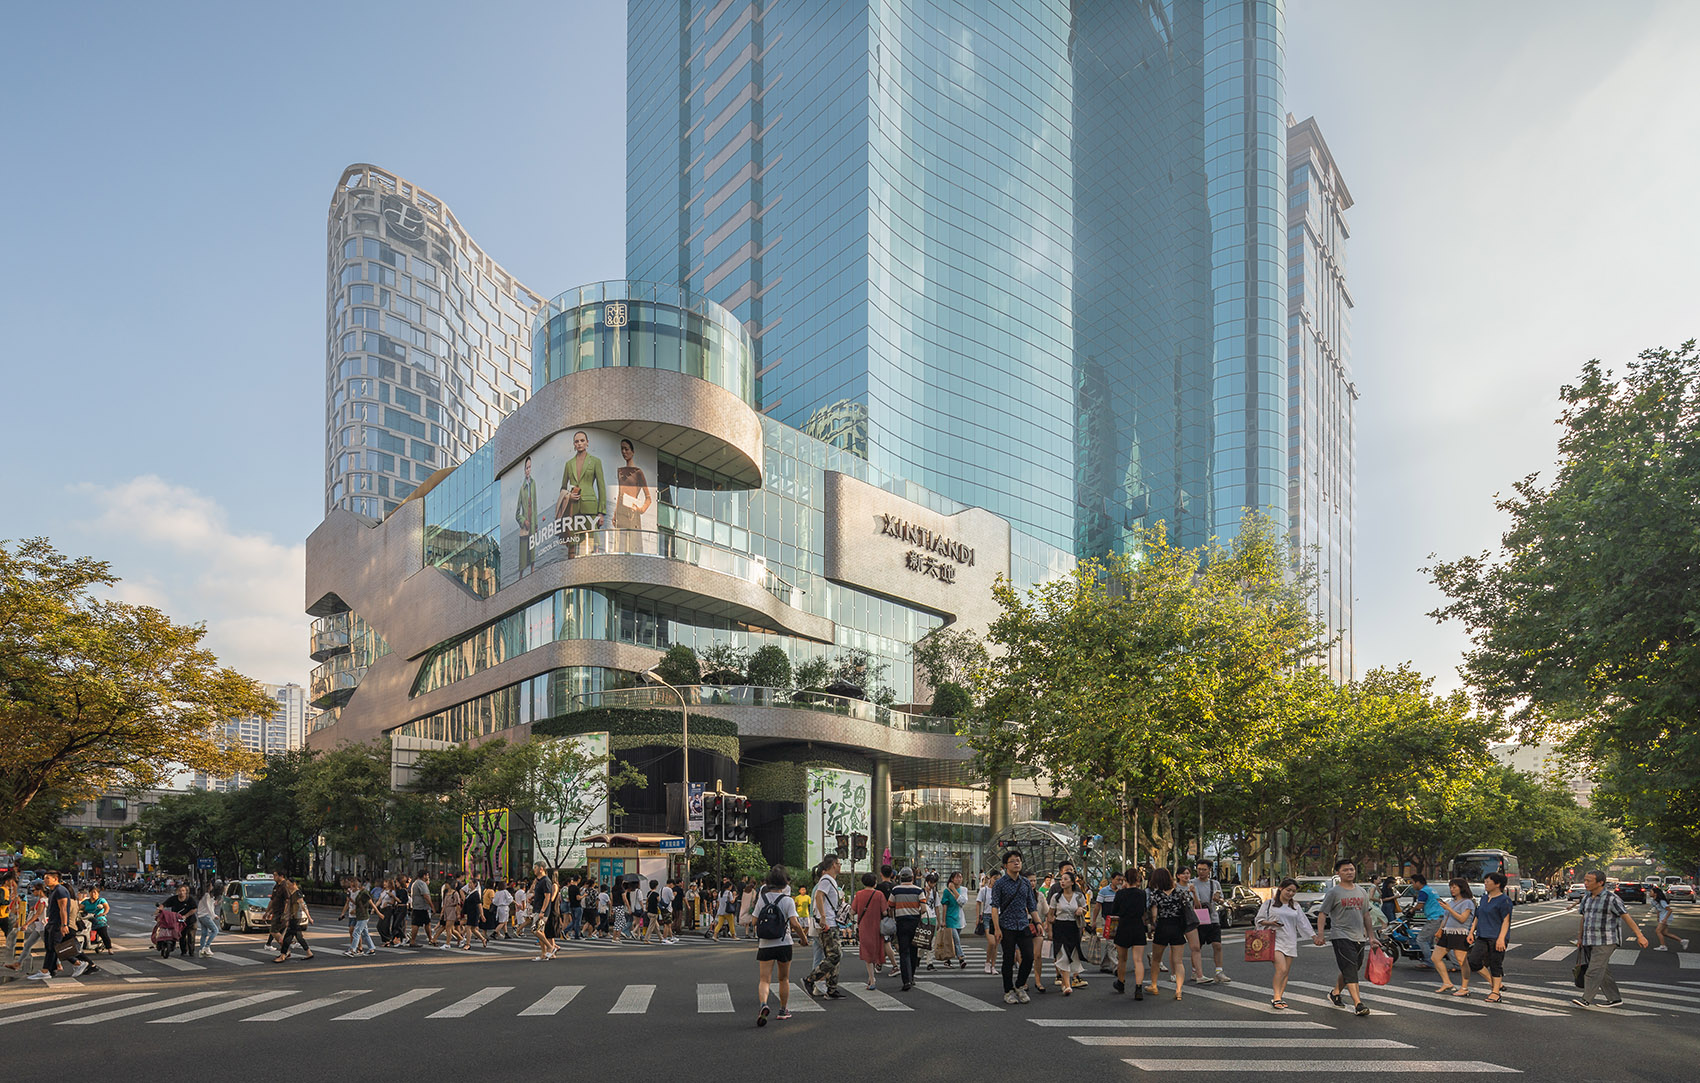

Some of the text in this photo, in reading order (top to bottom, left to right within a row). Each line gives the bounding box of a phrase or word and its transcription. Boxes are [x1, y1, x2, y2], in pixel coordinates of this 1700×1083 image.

[607, 305, 625, 316] RYE
[607, 315, 625, 325] &CO
[529, 515, 600, 550] BURBERRY
[882, 513, 976, 567] XINTIANDI
[906, 549, 956, 585] 新天地
[916, 927, 932, 936] COCO
